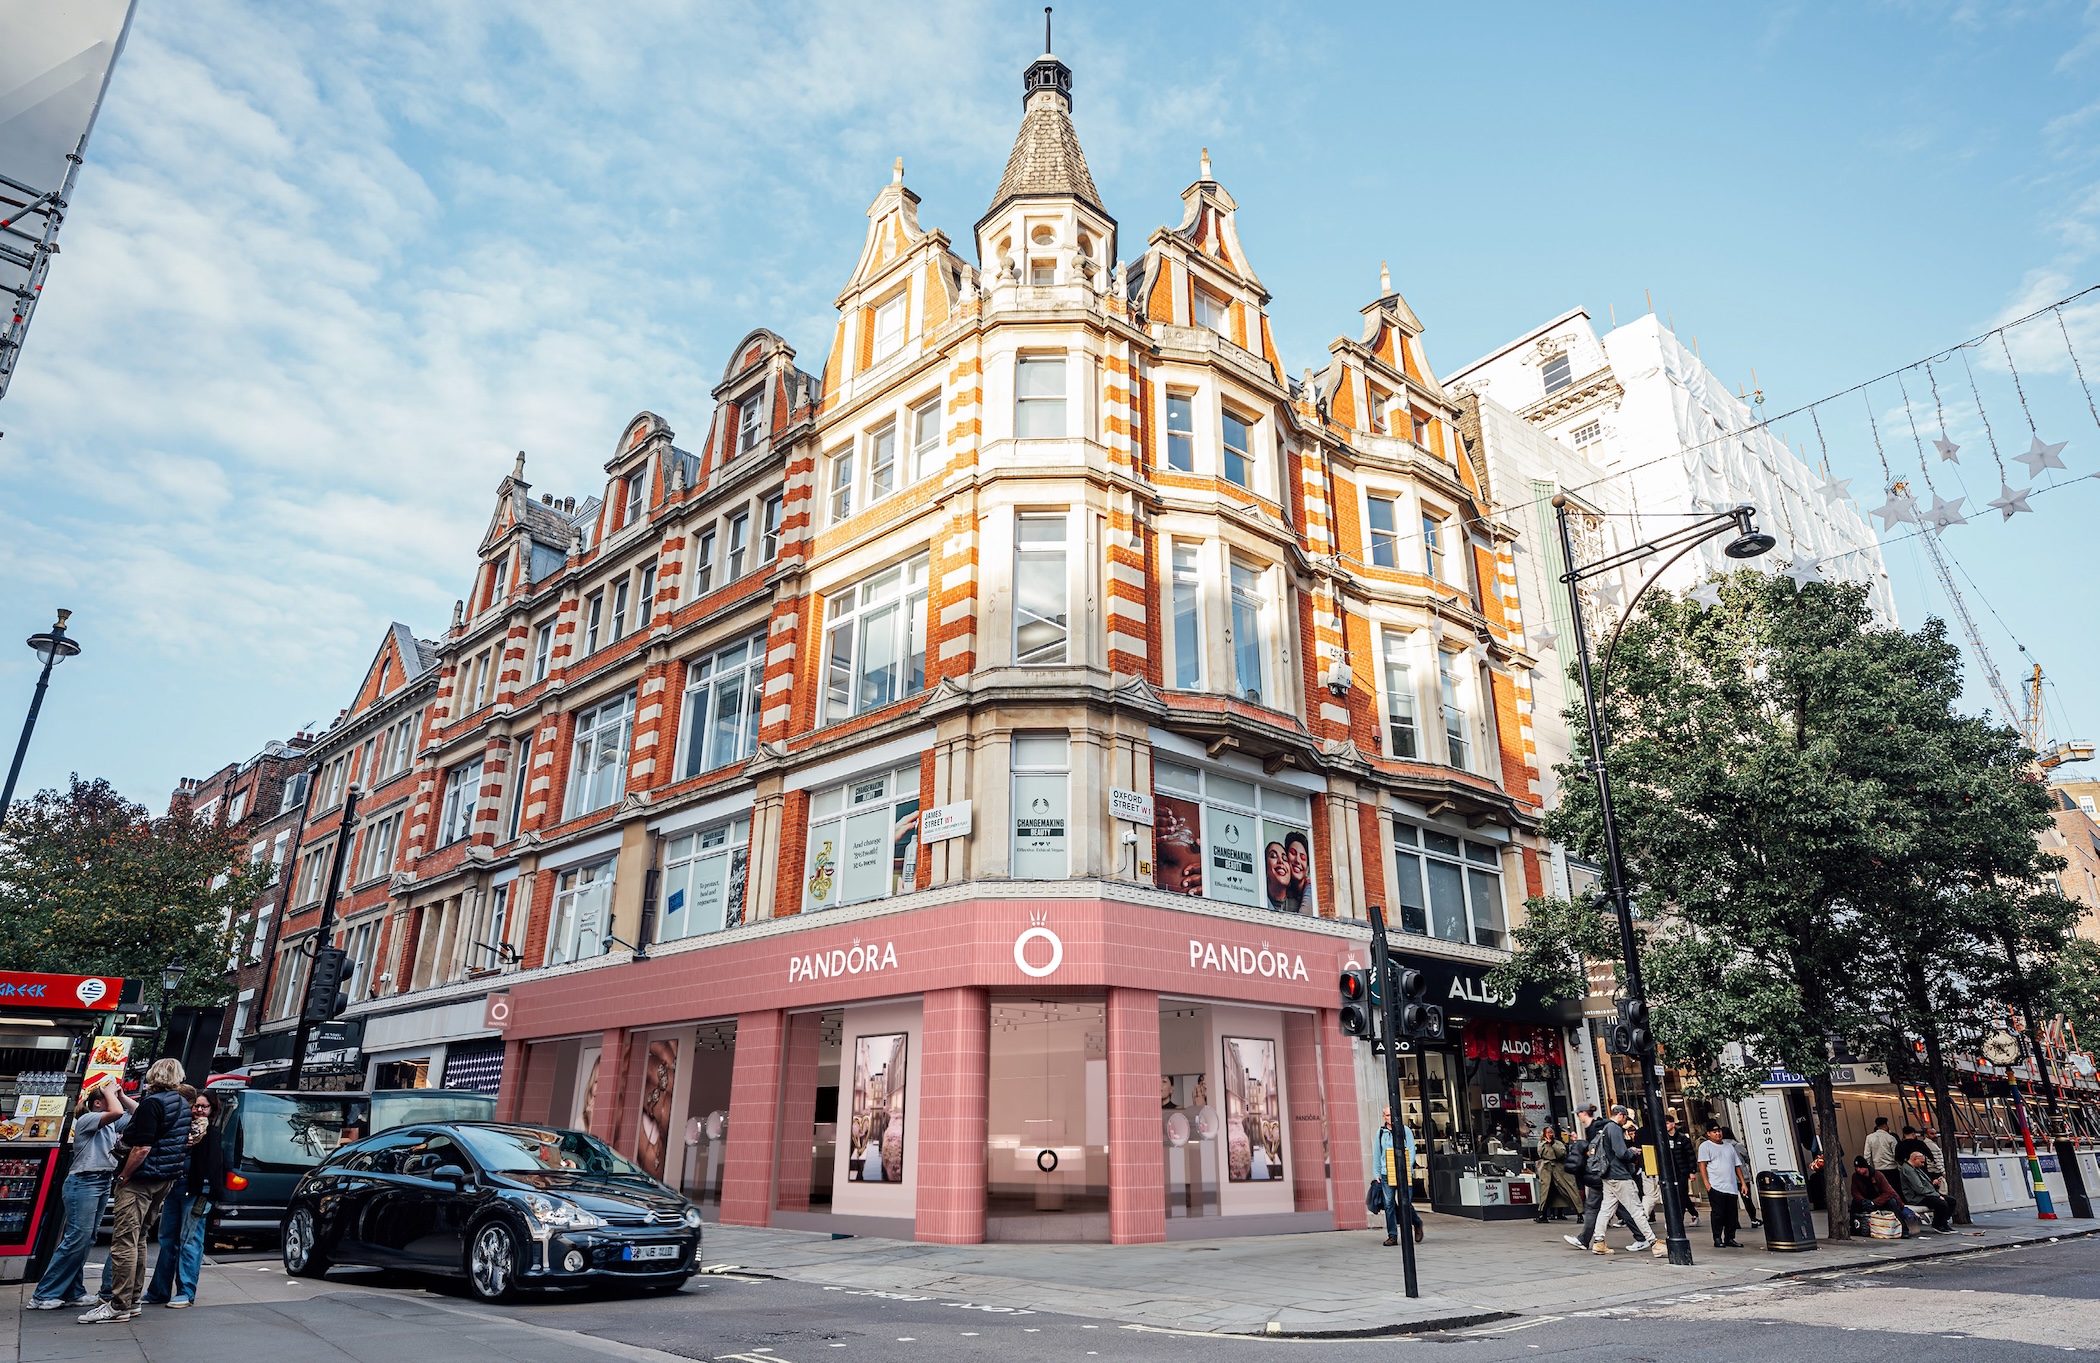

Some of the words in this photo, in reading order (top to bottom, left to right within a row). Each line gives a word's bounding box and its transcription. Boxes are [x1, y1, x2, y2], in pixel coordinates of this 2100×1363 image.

[1113, 790, 1143, 804] OXFORD
[1113, 799, 1140, 812] STREET
[1141, 806, 1151, 815] W1
[924, 810, 942, 820] JAMES
[924, 817, 944, 829] STREET
[945, 816, 953, 824] W1
[1017, 818, 1065, 828] CHANGEMAKING
[1030, 828, 1052, 836] BEAUTY
[853, 840, 863, 849] And
[863, 838, 881, 847] change
[1213, 845, 1253, 863] CHANGEMAKING
[789, 941, 898, 983] PANDORA
[1189, 940, 1309, 982] PANDORA
[0, 983, 47, 998] GREEK
[1584, 1008, 1619, 1016] intimissim
[1376, 1041, 1410, 1051] ADO
[1501, 1040, 1531, 1055] ALDO
[1830, 1070, 1851, 1080] PLC
[1522, 1101, 1546, 1110] Comfort
